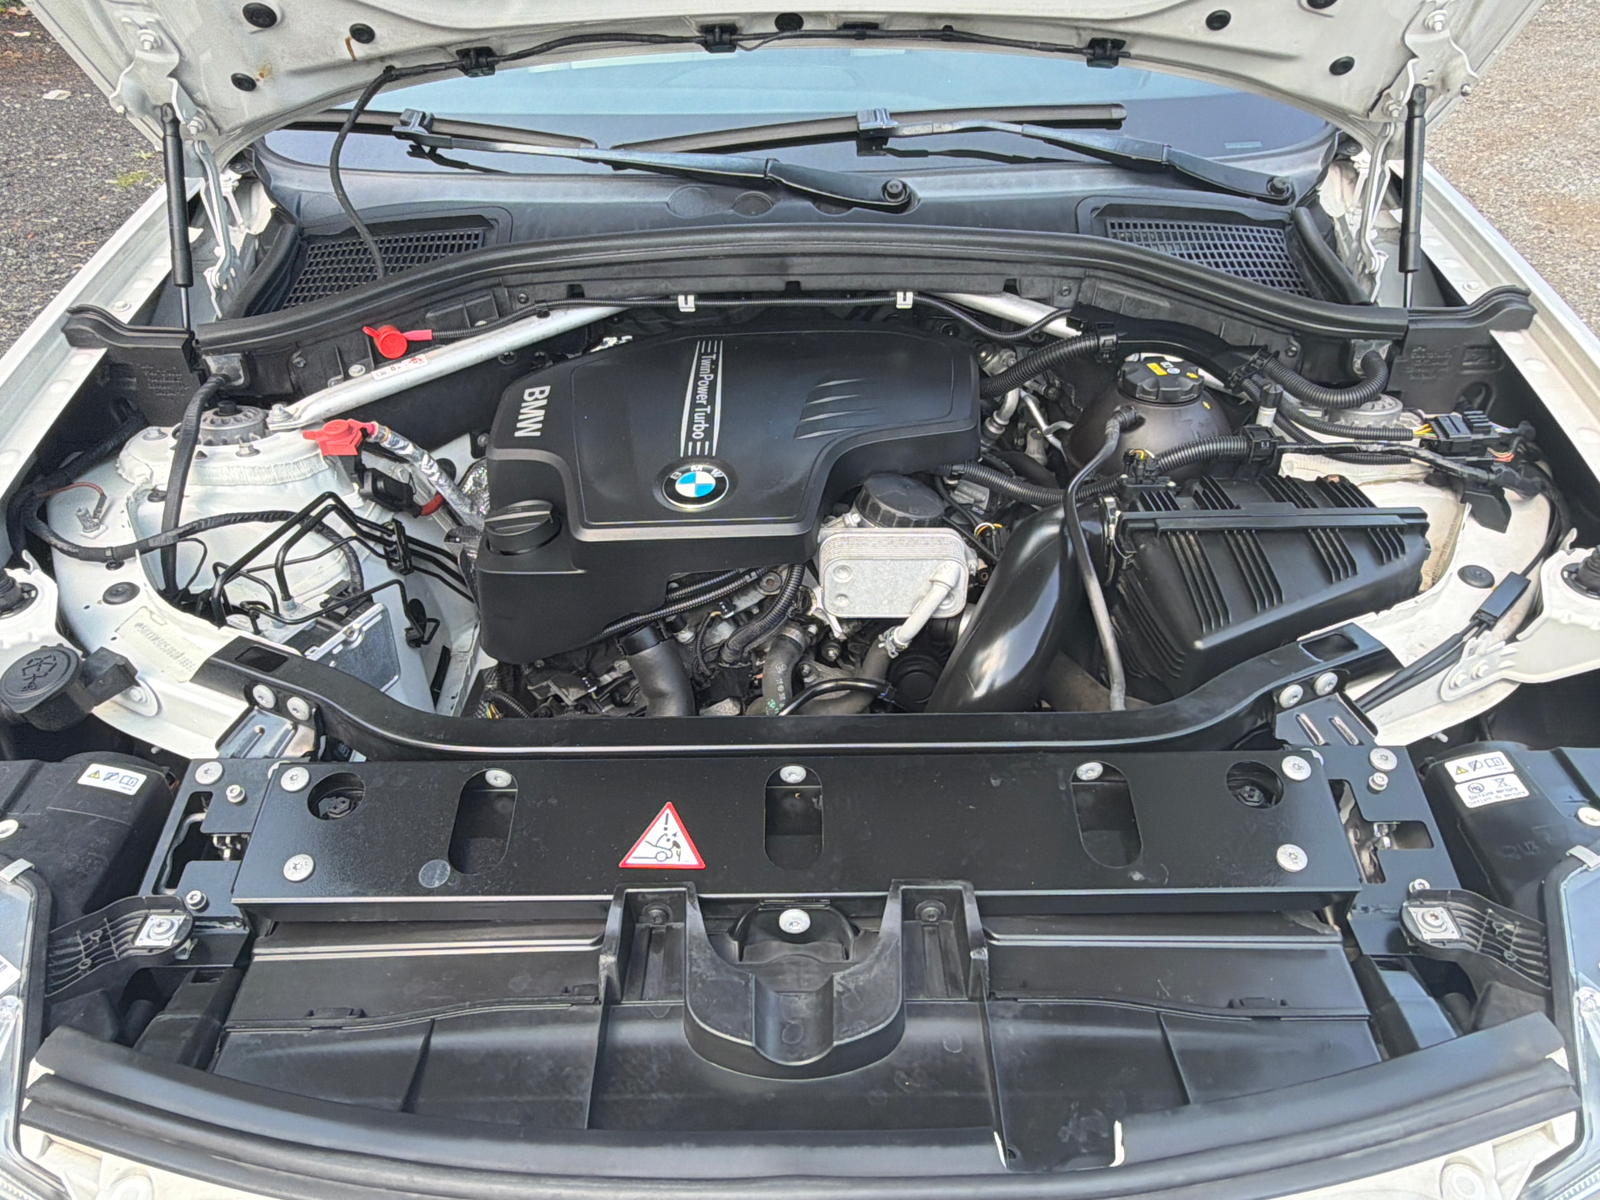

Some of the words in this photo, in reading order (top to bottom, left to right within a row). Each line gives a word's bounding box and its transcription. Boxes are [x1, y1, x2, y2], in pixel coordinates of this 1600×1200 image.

[695, 353, 717, 405] TwinPower
[514, 385, 551, 438] BMW
[691, 405, 711, 440] Turbo
[669, 464, 724, 480] BMW
